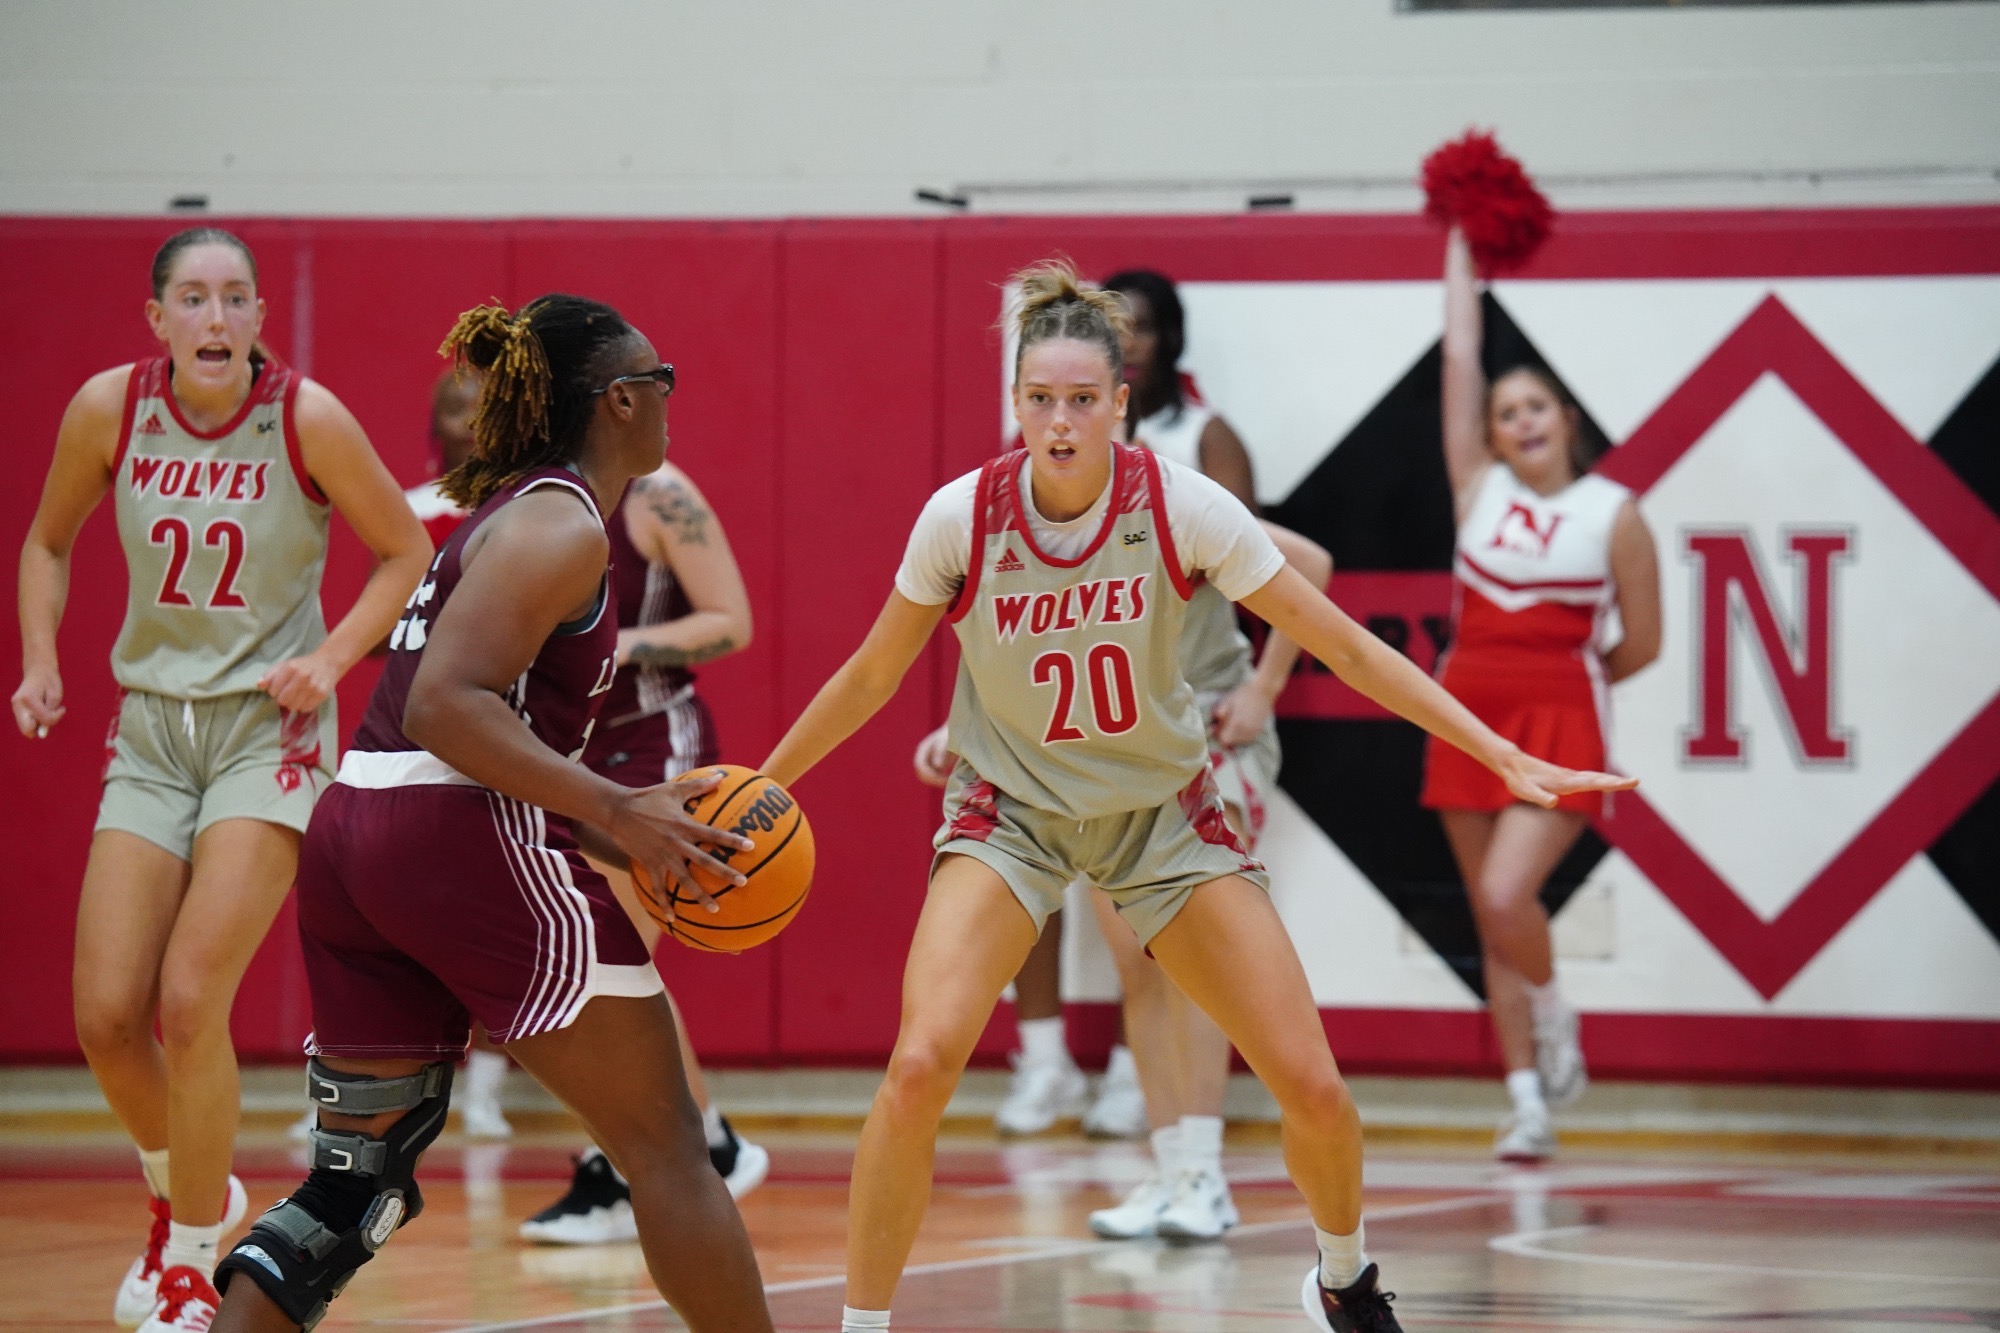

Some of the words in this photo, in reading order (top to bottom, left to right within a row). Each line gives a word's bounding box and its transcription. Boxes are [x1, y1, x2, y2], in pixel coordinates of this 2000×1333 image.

[131, 454, 275, 506] WOLVES
[149, 514, 247, 611] 22
[1123, 530, 1148, 546] SAC
[993, 573, 1152, 645] WOLVES
[1680, 526, 1857, 769] N
[1032, 641, 1140, 746] 20
